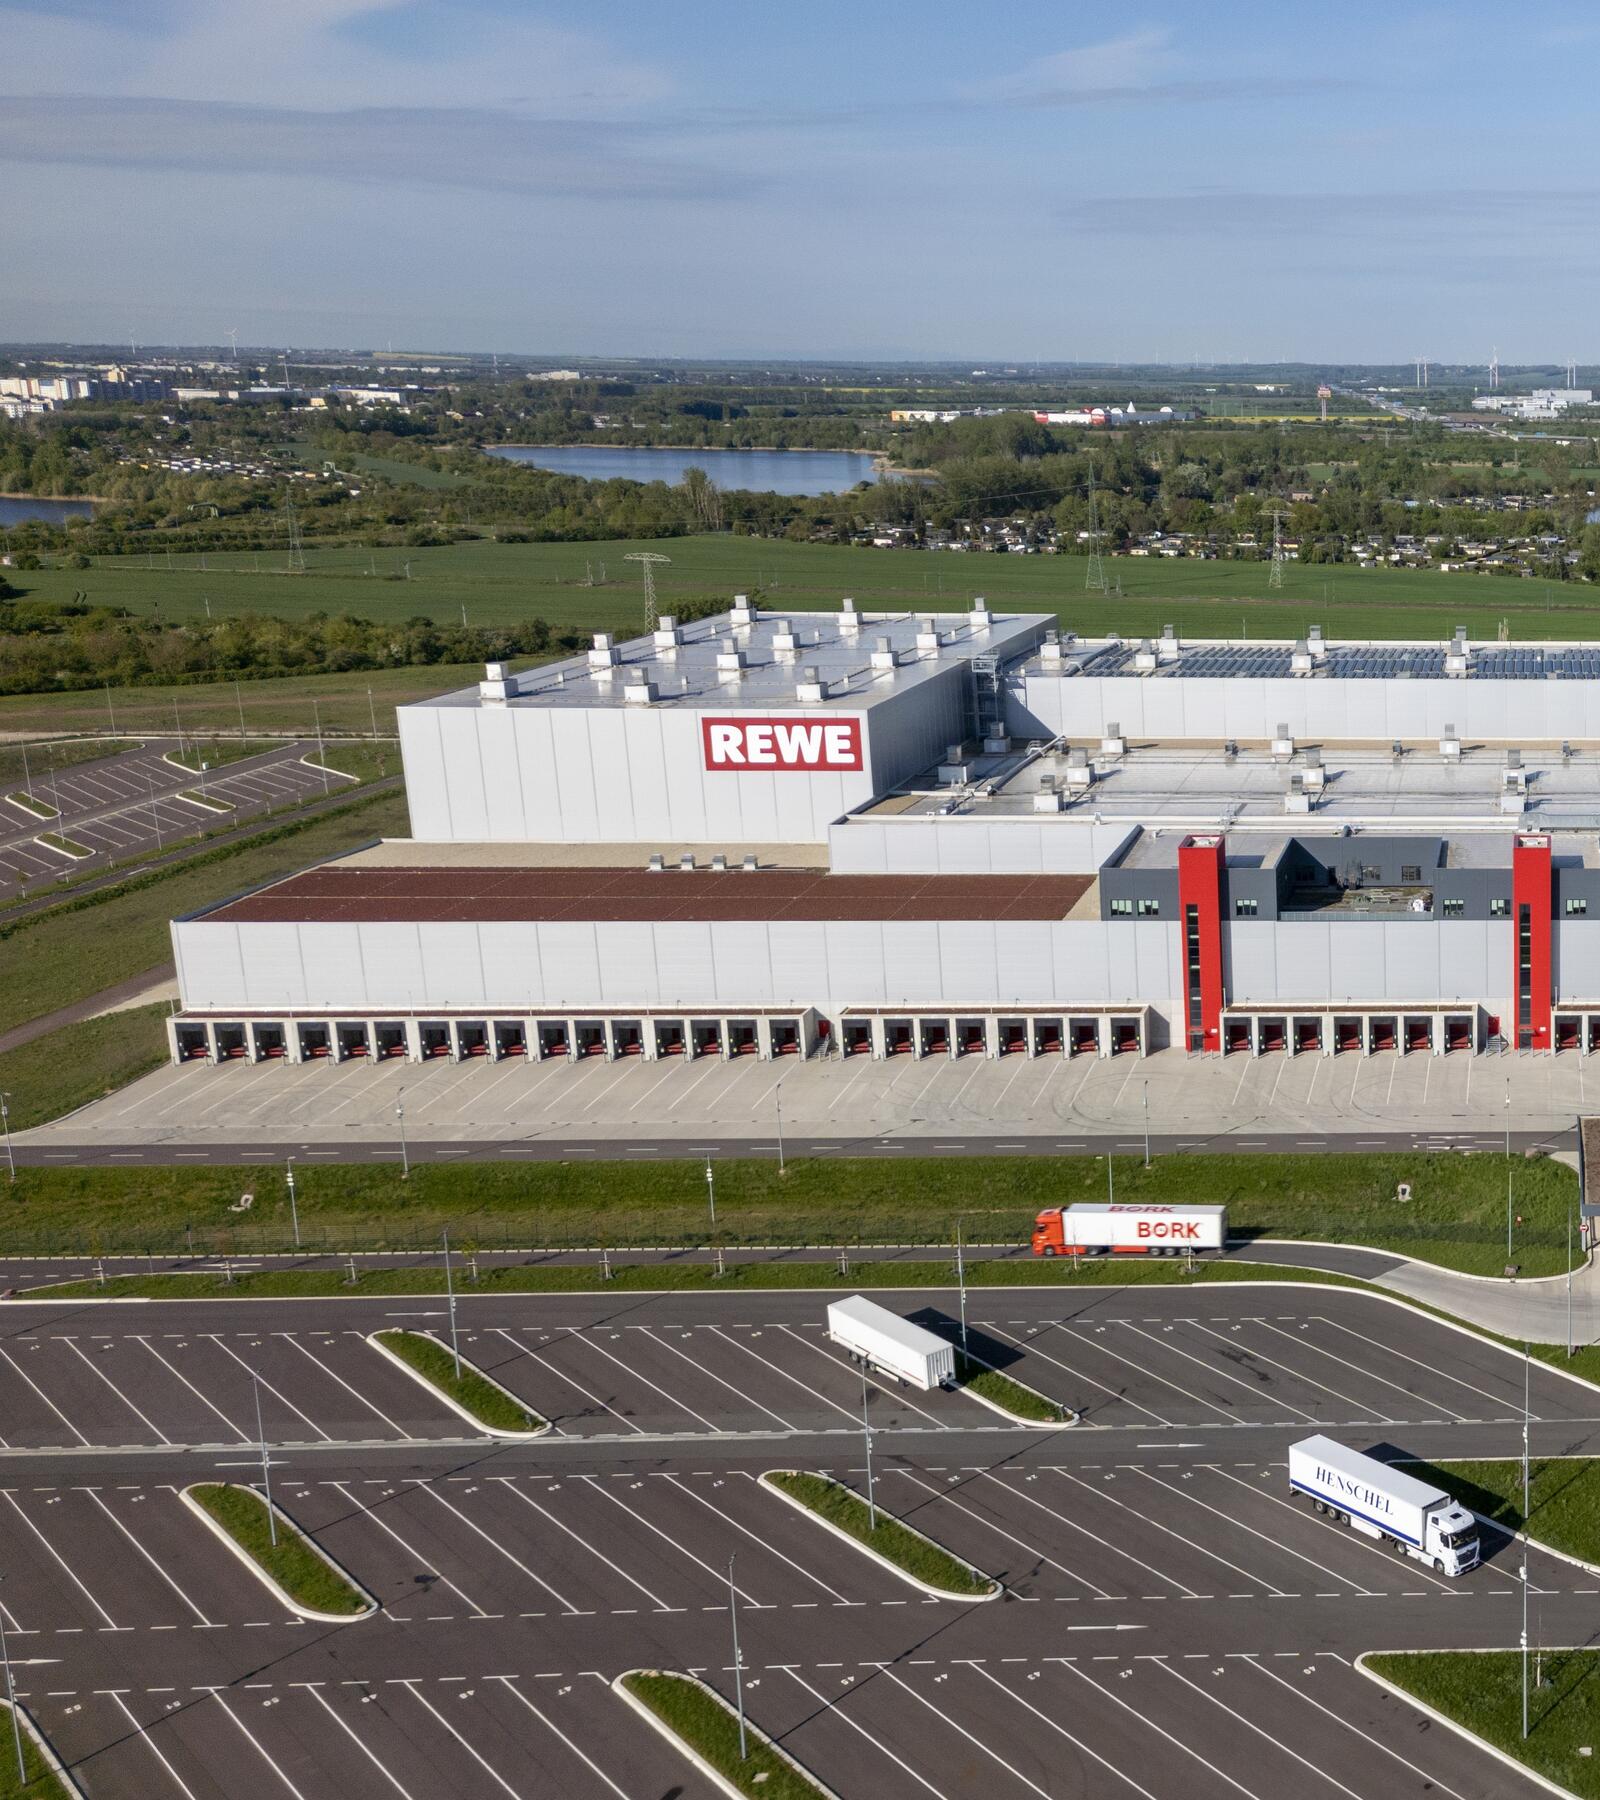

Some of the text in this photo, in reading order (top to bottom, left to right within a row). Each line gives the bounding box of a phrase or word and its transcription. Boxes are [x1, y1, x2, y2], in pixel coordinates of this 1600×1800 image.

[710, 725, 855, 764] REWE
[1108, 1205, 1176, 1213] BORK
[1138, 1222, 1200, 1238] BORK
[1316, 1466, 1394, 1515] HENSCHEL
